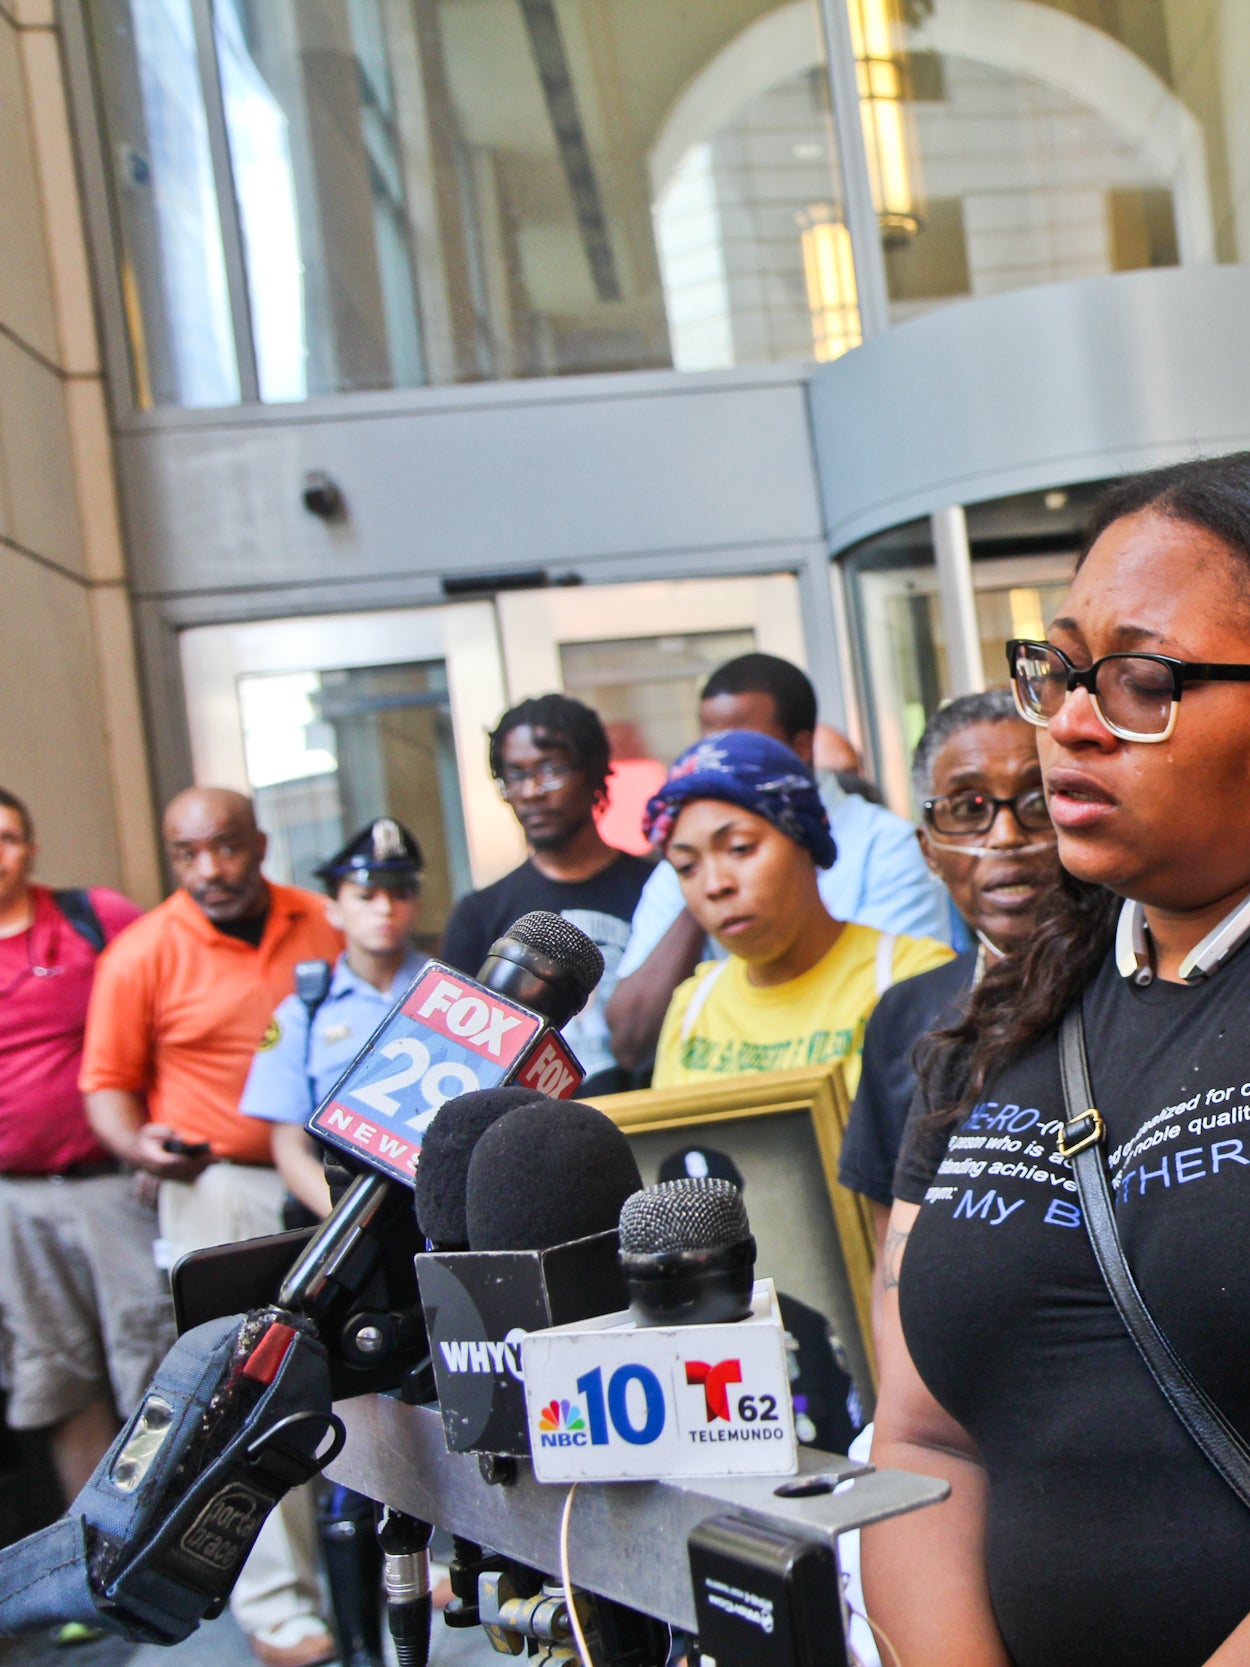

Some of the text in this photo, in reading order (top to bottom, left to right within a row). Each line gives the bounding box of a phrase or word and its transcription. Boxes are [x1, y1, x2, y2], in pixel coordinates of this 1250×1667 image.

[417, 979, 523, 1057] FOX
[348, 1037, 480, 1133] 29
[526, 1044, 576, 1100] FOX
[985, 1134, 1023, 1153] who
[1023, 1140, 1045, 1158] is
[1204, 1087, 1236, 1106] for
[987, 1162, 1079, 1193] achieve
[1132, 1123, 1182, 1158] noble
[577, 1363, 666, 1445] 10
[688, 1427, 784, 1443] TELEMUNDO
[737, 1394, 779, 1422] 62
[540, 1432, 588, 1448] NBC
